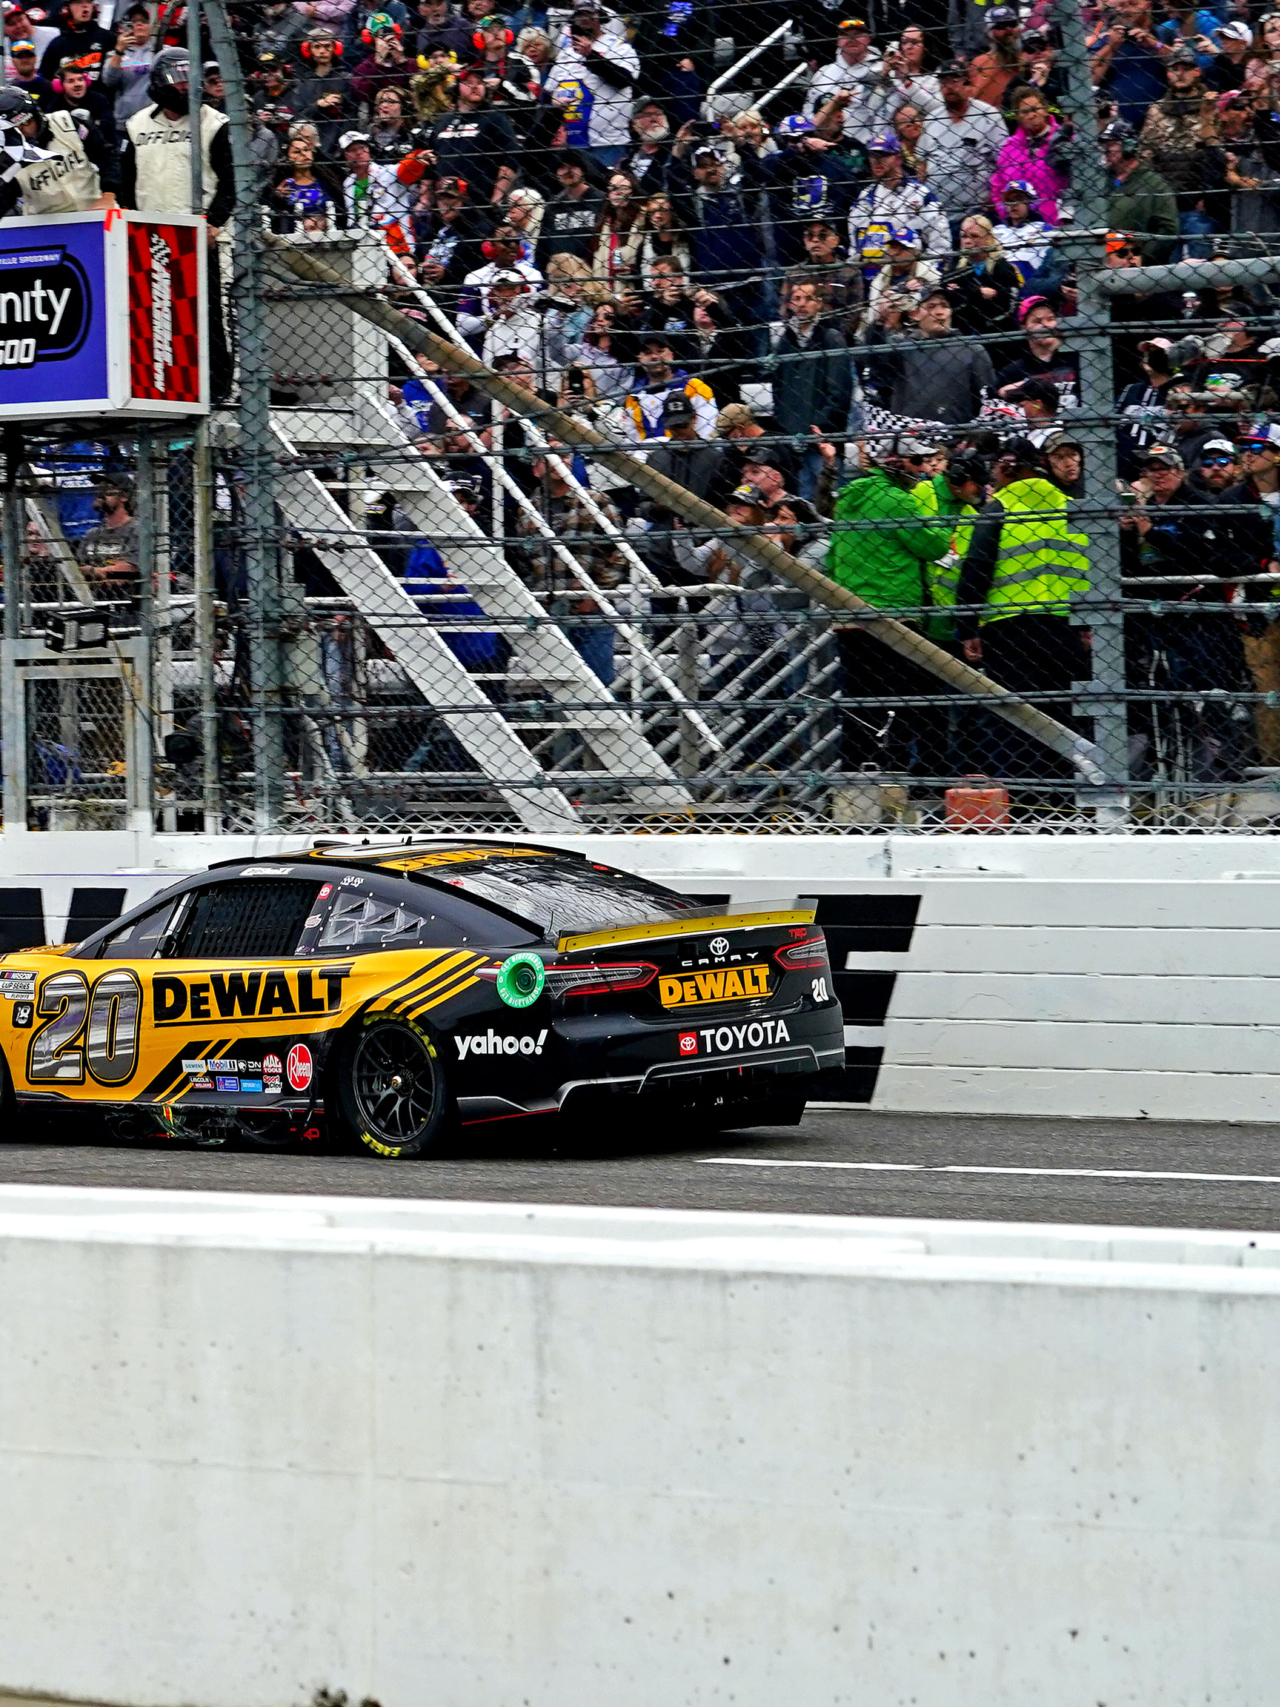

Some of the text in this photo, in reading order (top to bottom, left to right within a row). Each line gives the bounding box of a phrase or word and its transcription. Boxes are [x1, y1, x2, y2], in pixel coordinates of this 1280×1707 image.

[135, 131, 192, 146] OFFICIA
[29, 150, 84, 191] OFFICIAL
[681, 951, 759, 967] CAMRY
[152, 966, 351, 1021] DEWALT
[658, 967, 771, 1005] DEWALT
[811, 977, 829, 1002] 20
[28, 970, 141, 1086] 20
[453, 1029, 548, 1061] yahoo!
[700, 1019, 791, 1053] TOYOTA
[209, 1060, 228, 1069] Mobil
[290, 1045, 311, 1082] Rheem
